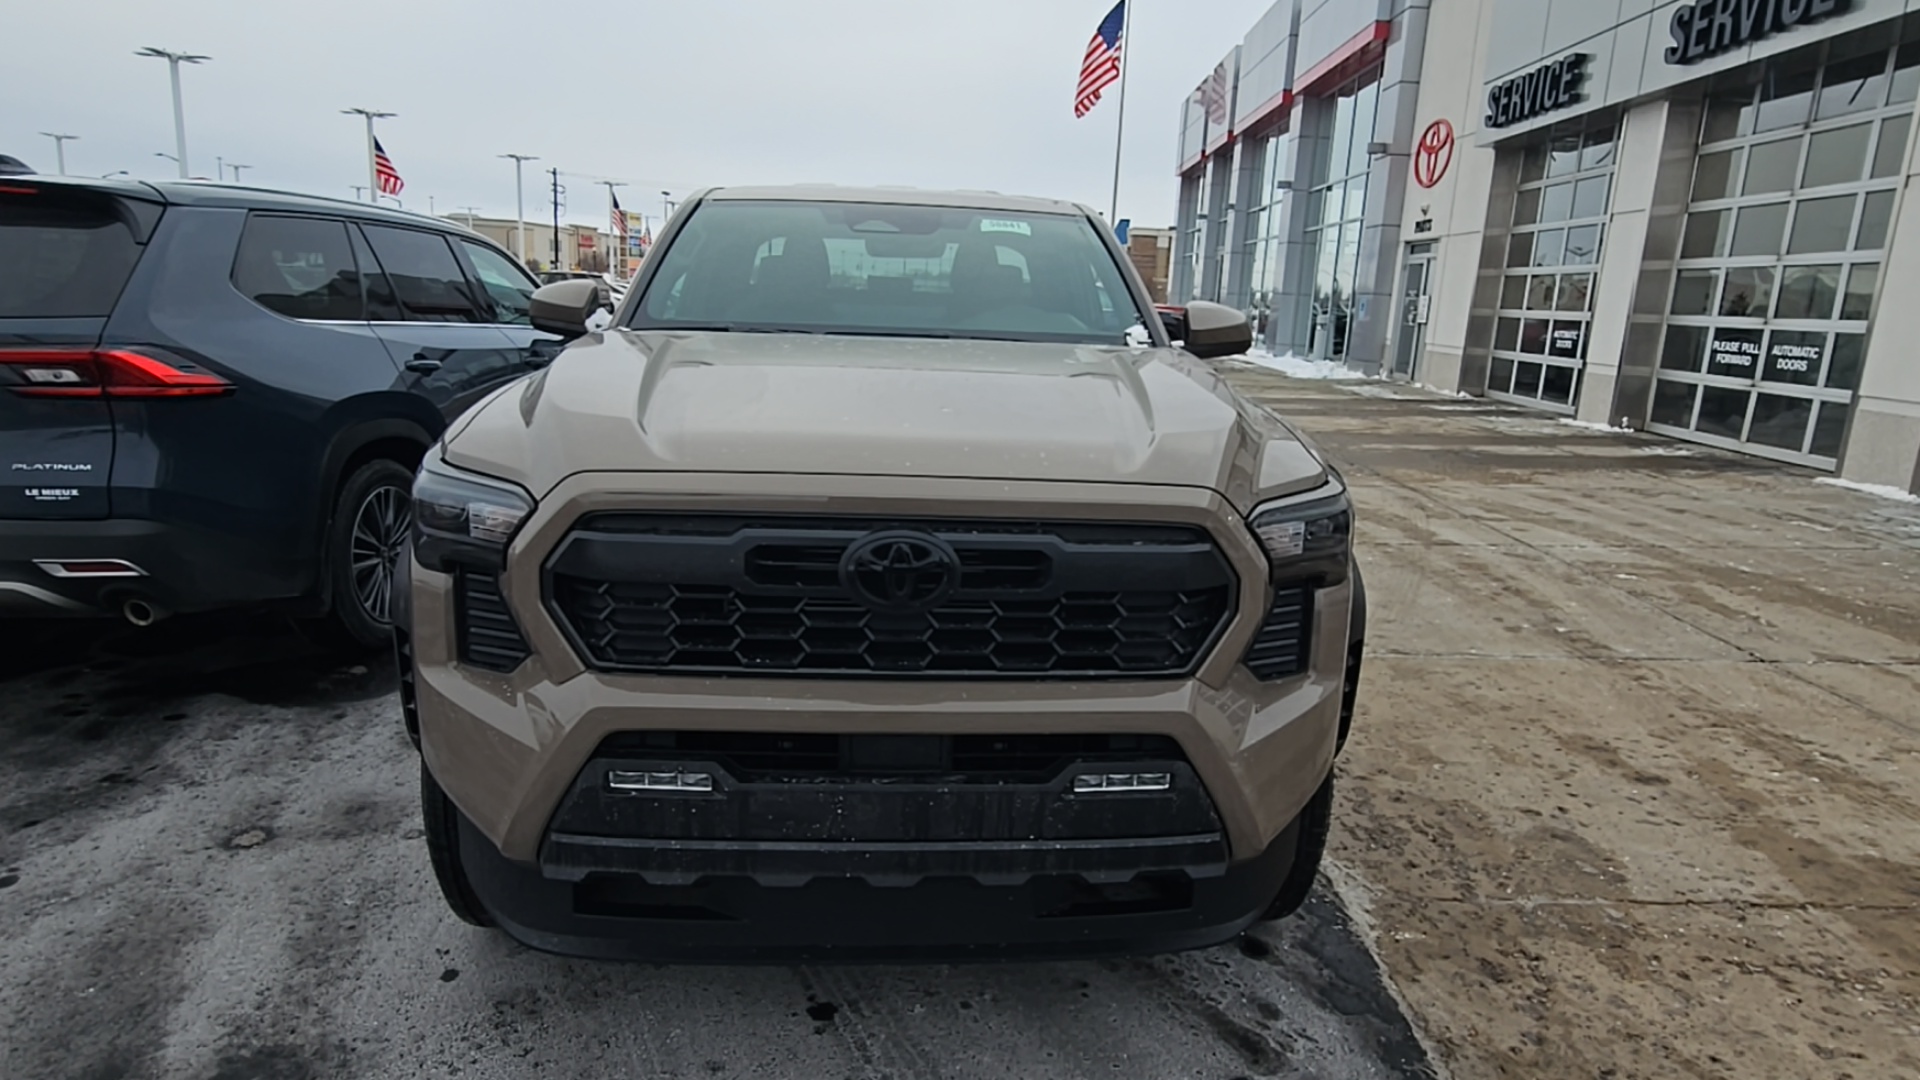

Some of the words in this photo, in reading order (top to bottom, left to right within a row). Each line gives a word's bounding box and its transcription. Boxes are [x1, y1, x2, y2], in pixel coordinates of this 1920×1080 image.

[1485, 54, 1584, 128] SERVICE
[1712, 340, 1741, 353] PLEASE
[1741, 342, 1760, 354] PULL
[1771, 345, 1820, 359] AUTOMATIC
[1716, 353, 1752, 366] FORWARD
[1776, 358, 1809, 372] DOORS
[11, 463, 92, 471] PLATINUM
[25, 488, 39, 496] LE
[41, 488, 80, 496] MIEUX
